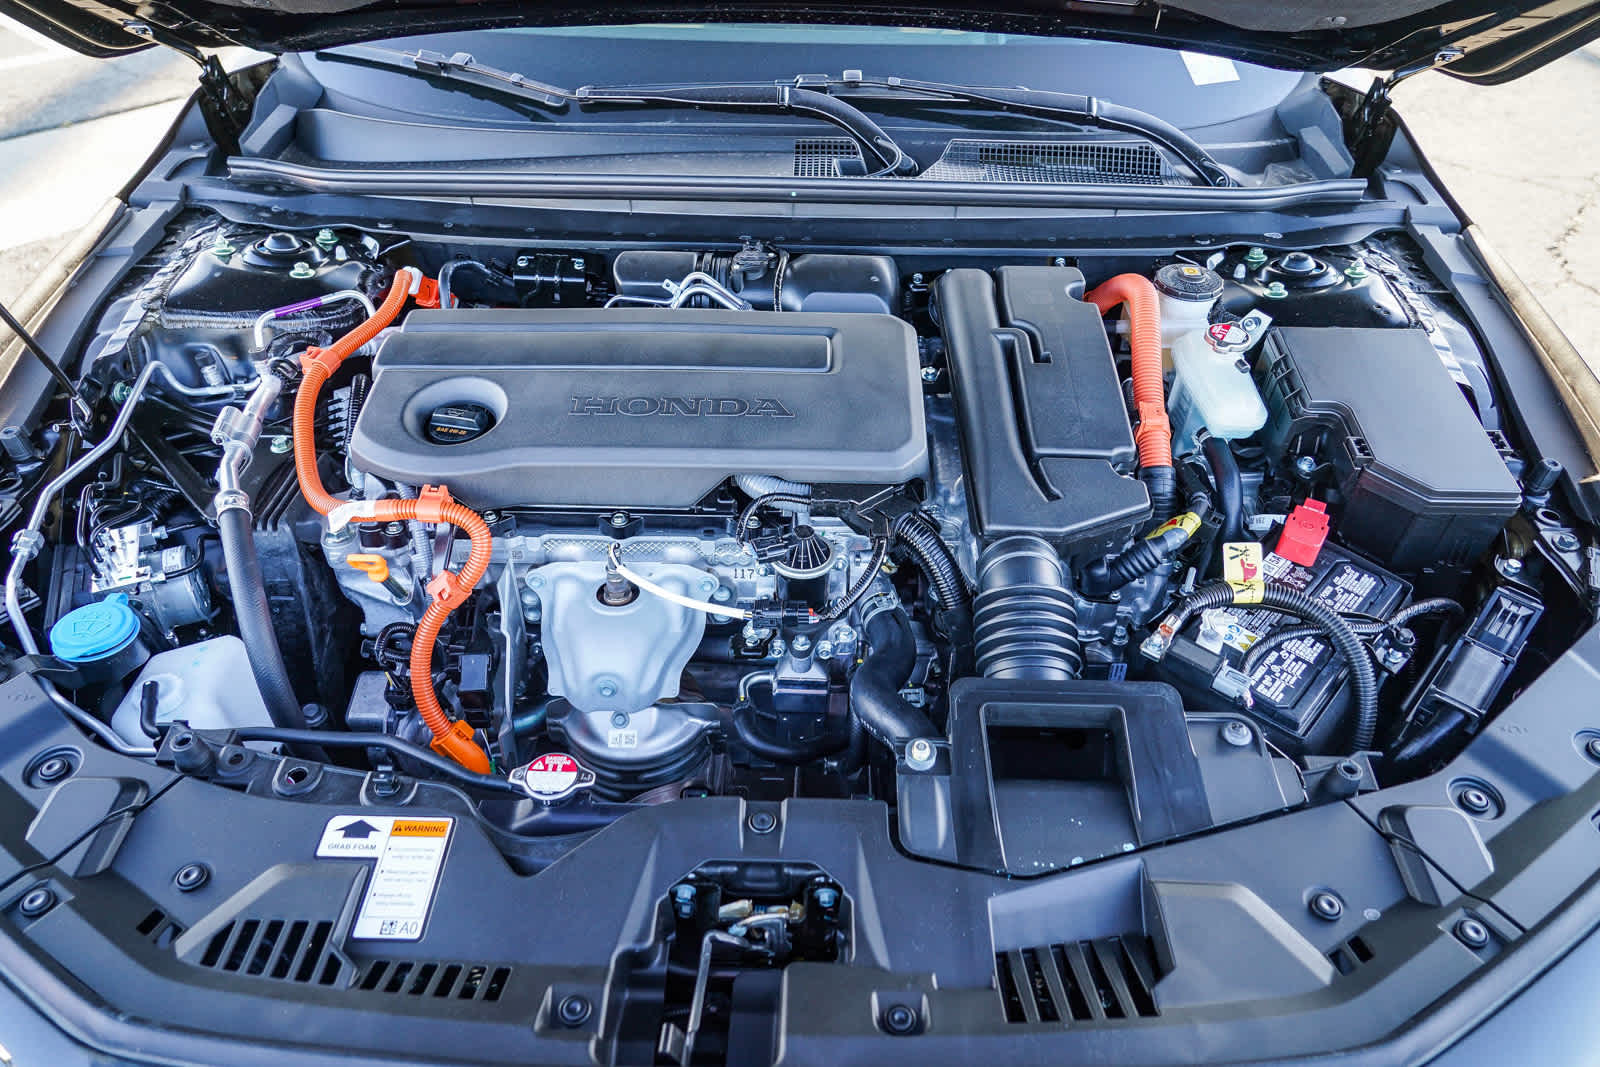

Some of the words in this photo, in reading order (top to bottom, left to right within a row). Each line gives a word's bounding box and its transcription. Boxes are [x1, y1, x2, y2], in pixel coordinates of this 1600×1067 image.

[568, 396, 796, 418] HONDA
[733, 568, 755, 579] 117
[403, 825, 445, 833] WARNING
